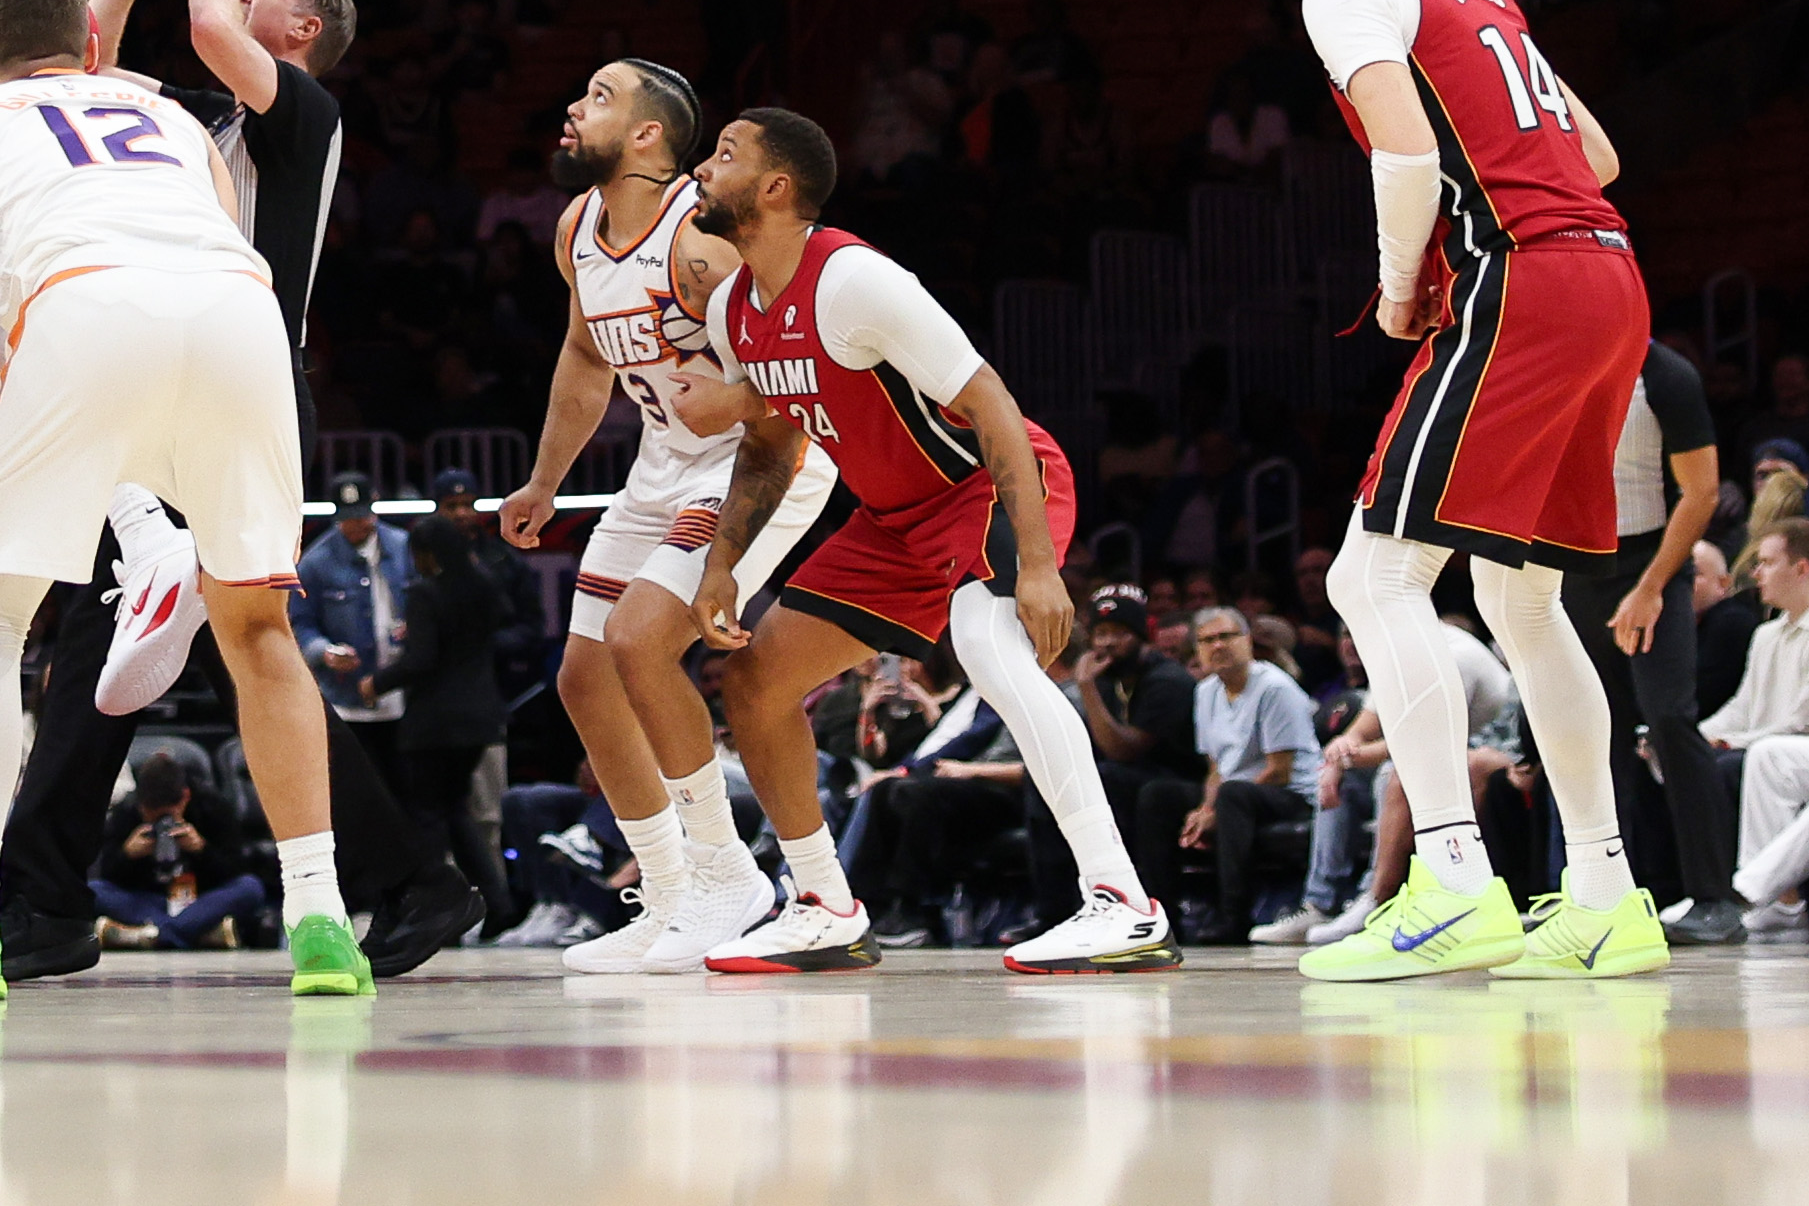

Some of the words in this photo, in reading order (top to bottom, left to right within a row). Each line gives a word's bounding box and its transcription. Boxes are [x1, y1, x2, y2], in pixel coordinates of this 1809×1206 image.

[1477, 25, 1574, 132] 14
[37, 105, 186, 168] 12
[635, 253, 664, 269] PayPal
[586, 314, 661, 365] UNS
[789, 402, 841, 444] 24
